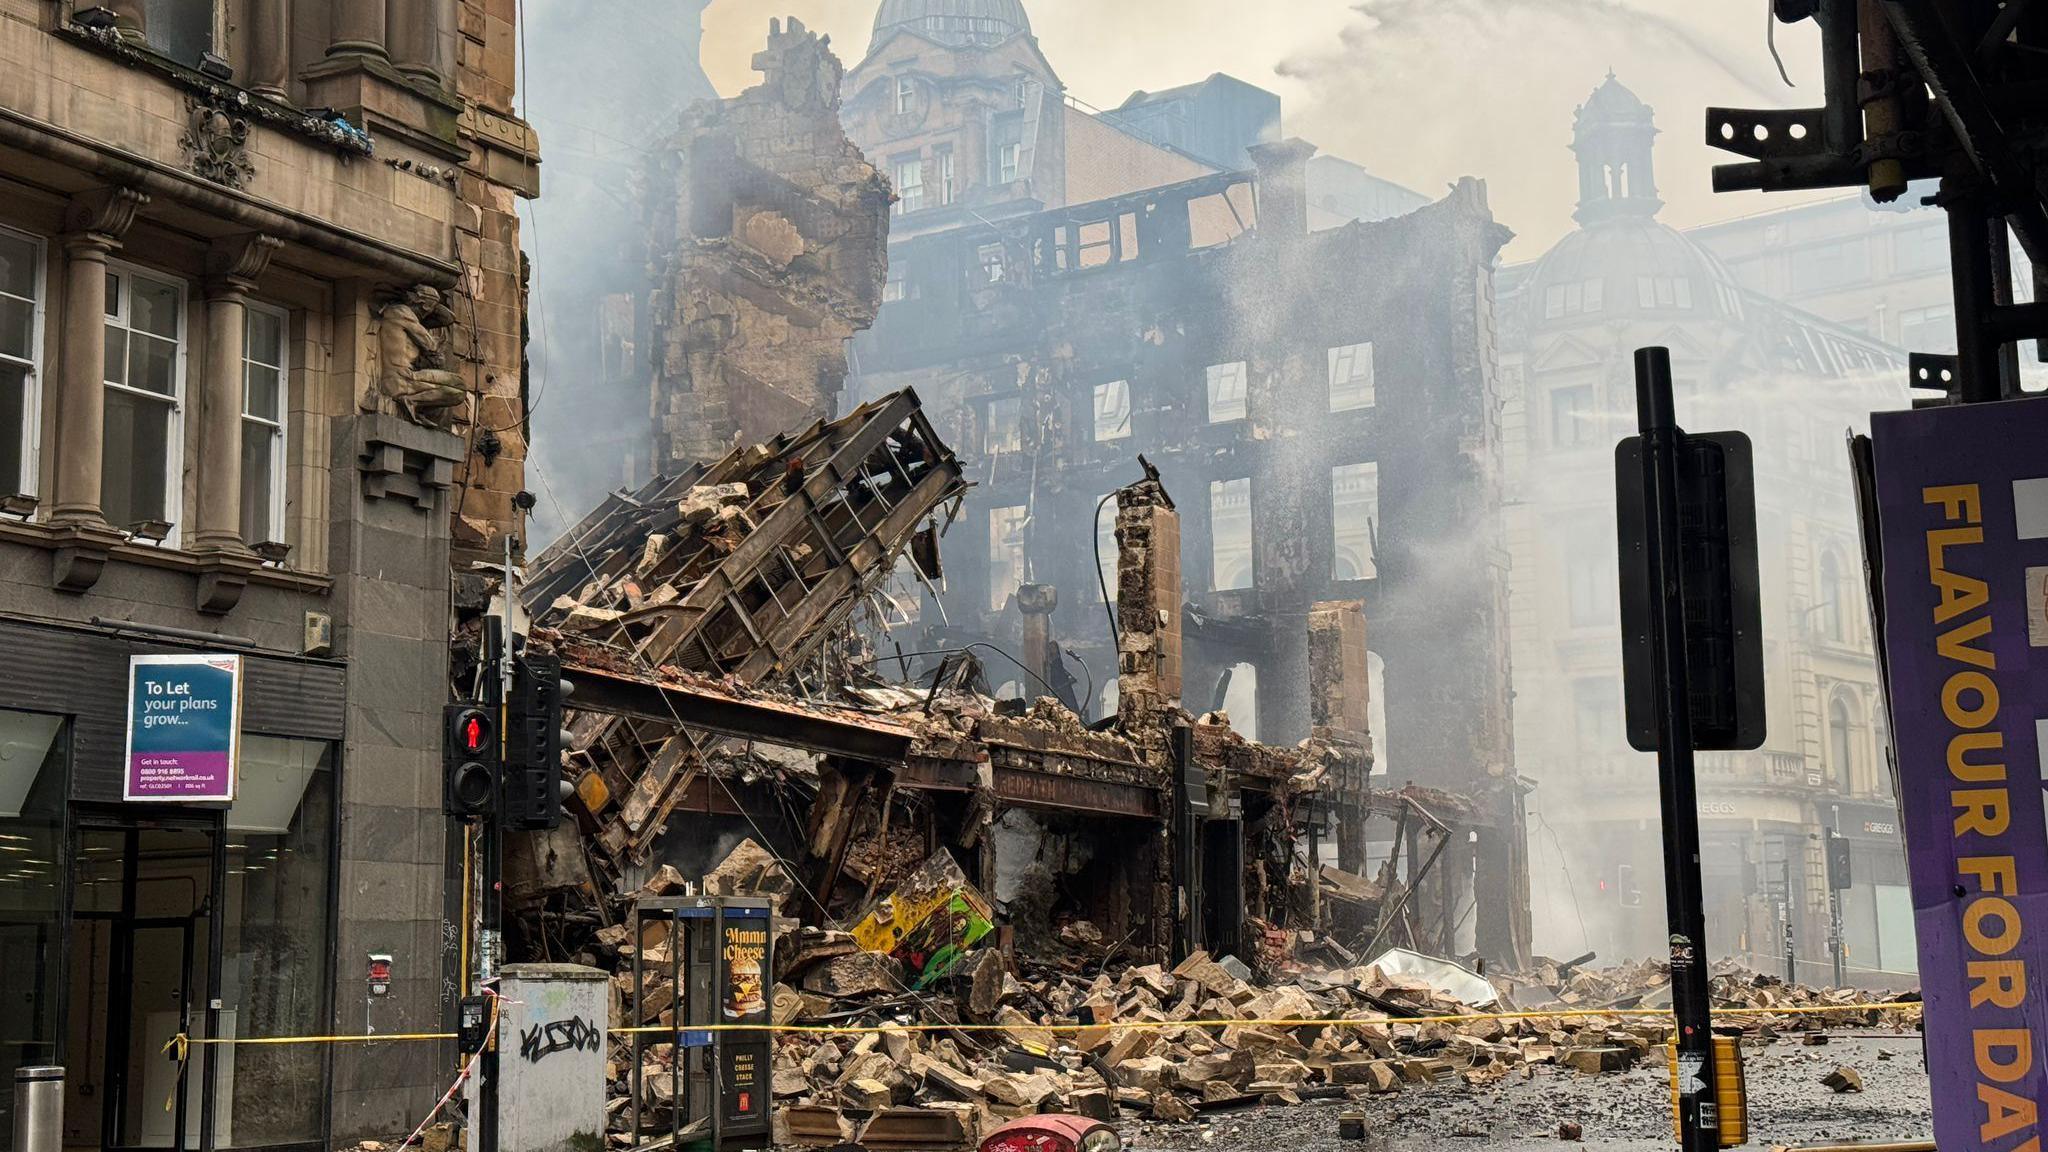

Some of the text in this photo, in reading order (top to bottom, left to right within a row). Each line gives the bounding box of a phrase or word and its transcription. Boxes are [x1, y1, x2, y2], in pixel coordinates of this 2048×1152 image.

[1922, 483, 2011, 838] FLAVOUR
[145, 681, 190, 695] To Let
[144, 696, 217, 713] your plans
[144, 715, 188, 728] grow...
[1699, 801, 1736, 815] EGGS
[1957, 856, 2027, 1009] FOR
